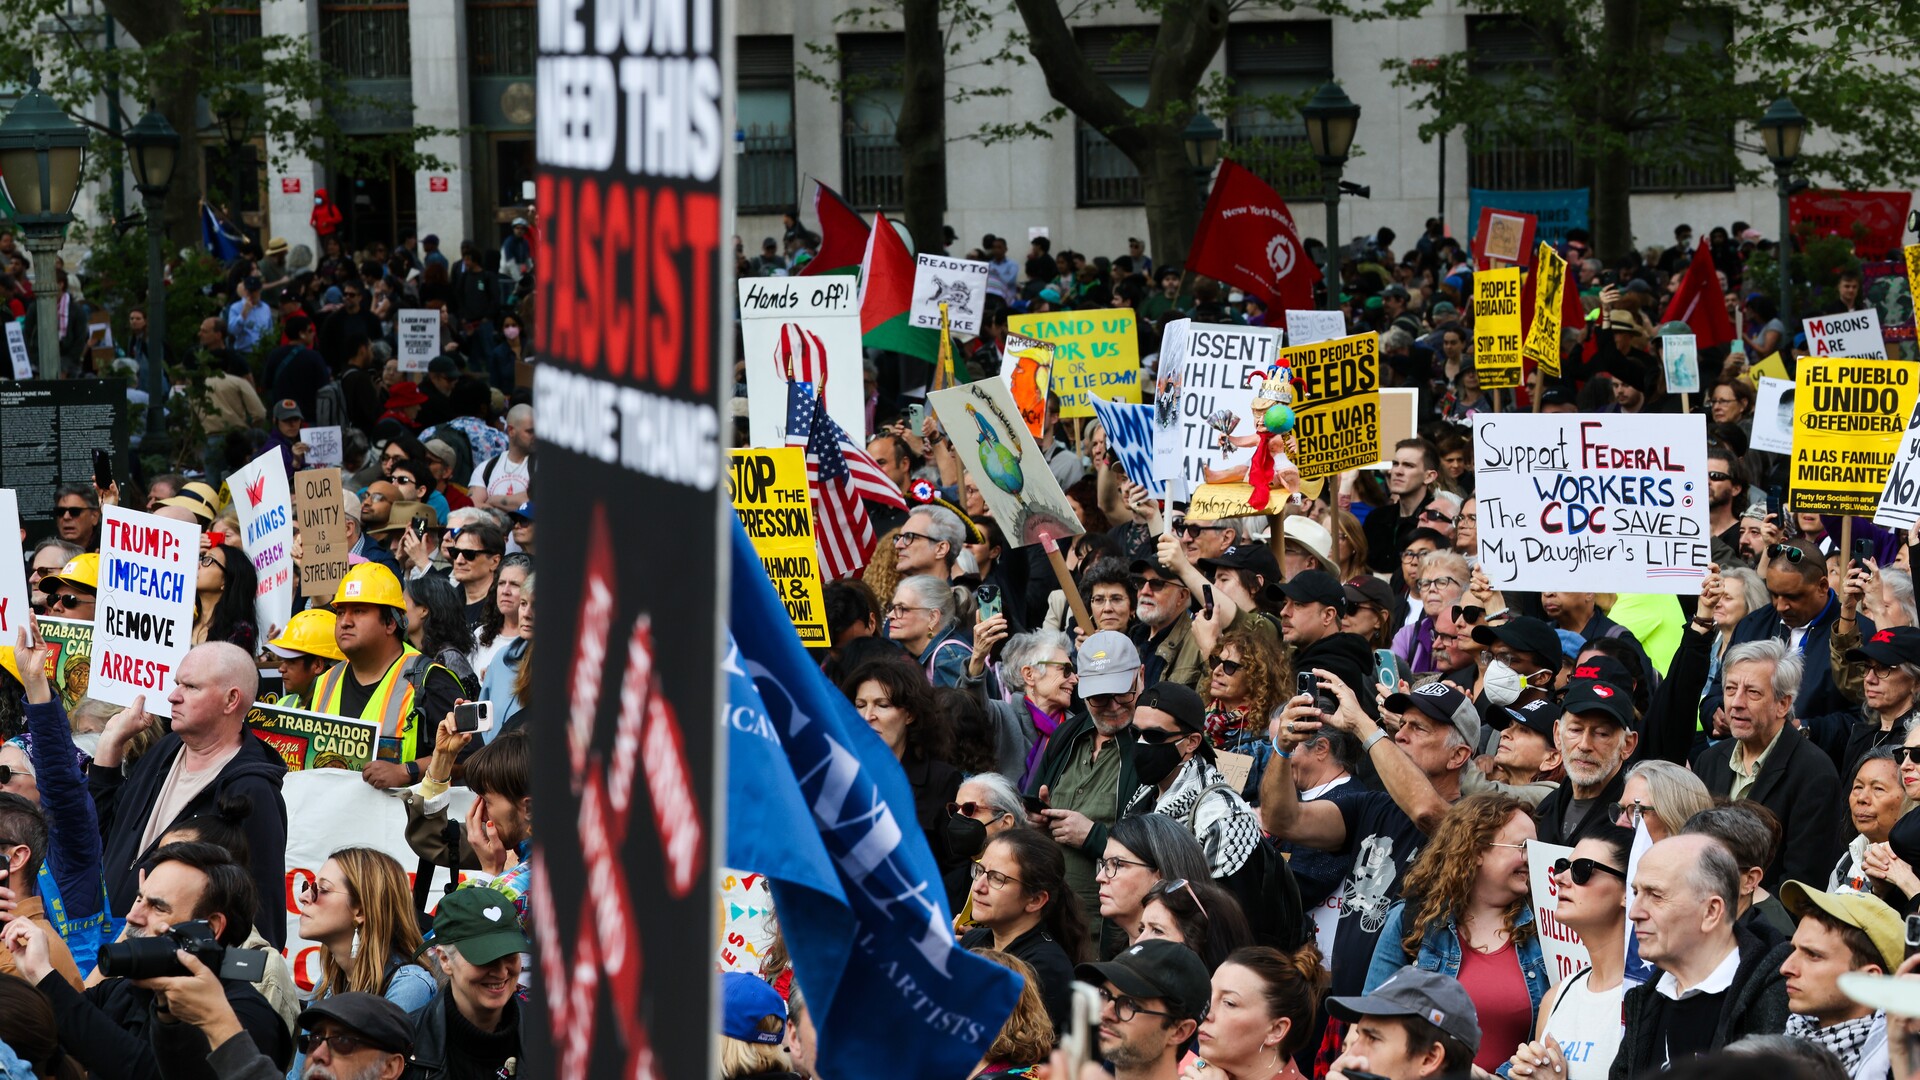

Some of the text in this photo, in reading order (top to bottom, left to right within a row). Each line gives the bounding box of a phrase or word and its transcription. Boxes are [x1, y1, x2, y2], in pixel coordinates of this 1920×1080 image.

[536, 55, 722, 182] NEED THIS
[1222, 206, 1248, 219] New
[1249, 205, 1270, 217] York
[918, 255, 988, 275] READY TO
[536, 173, 720, 394] FASCIST
[1481, 281, 1517, 299] PEOPLE
[744, 283, 799, 309] Hands
[410, 324, 427, 332] NOW
[1020, 318, 1132, 339] STAND UP
[1809, 316, 1870, 338] MORONS
[1054, 342, 1086, 361] OR
[1090, 341, 1120, 358] US
[1189, 332, 1272, 363] ISSENT
[1284, 338, 1375, 368] FUND PEOPLE'S
[1498, 335, 1518, 352] THE
[1817, 338, 1846, 356] ARE
[1068, 361, 1087, 374] OR
[1073, 373, 1096, 388] LIE
[1099, 369, 1137, 385] DOWN
[1291, 354, 1376, 403] NEEDS
[1838, 366, 1909, 387] PUEBLO
[1060, 394, 1075, 407] ITH
[1184, 392, 1215, 421] OU
[1813, 386, 1899, 416] UNIDO
[1292, 402, 1377, 439] NOT WAR
[1805, 413, 1904, 433] DEFENDERÁ
[310, 431, 335, 443] FREE
[1299, 423, 1377, 455] ENOCIDE &
[1480, 422, 1685, 474] Support FEDERAL
[308, 441, 338, 458] OSTERS
[1798, 449, 1896, 466] A LAS FAMILIA
[1299, 452, 1378, 478] NSWER COALITION
[306, 478, 332, 500] OUR
[724, 455, 805, 504] STOP THE
[1796, 492, 1874, 504] Party for Socialism and
[1796, 501, 1831, 510] Liberation
[255, 505, 287, 540] KINGS
[303, 504, 339, 528] UNITY
[740, 508, 811, 538] PRESSION
[1480, 498, 1700, 536] The CDC SAVED
[106, 518, 180, 562] TRUMP:
[318, 531, 326, 541] IS
[315, 545, 331, 554] OUR
[1481, 536, 1708, 583] My Daughter's LIFE
[108, 558, 185, 604] IMPEACH
[256, 567, 288, 598] ANGE MAN
[304, 561, 348, 584] STRENGTH
[790, 579, 810, 600] &
[40, 623, 94, 641] TRABAJA
[106, 605, 175, 648] REMOVE
[797, 628, 824, 638] BERATION
[100, 650, 170, 692] ARREST
[262, 716, 277, 728] del
[277, 713, 371, 743] TRABAJADOR
[280, 742, 299, 754] 28th
[879, 960, 986, 1045] ARTISTS
